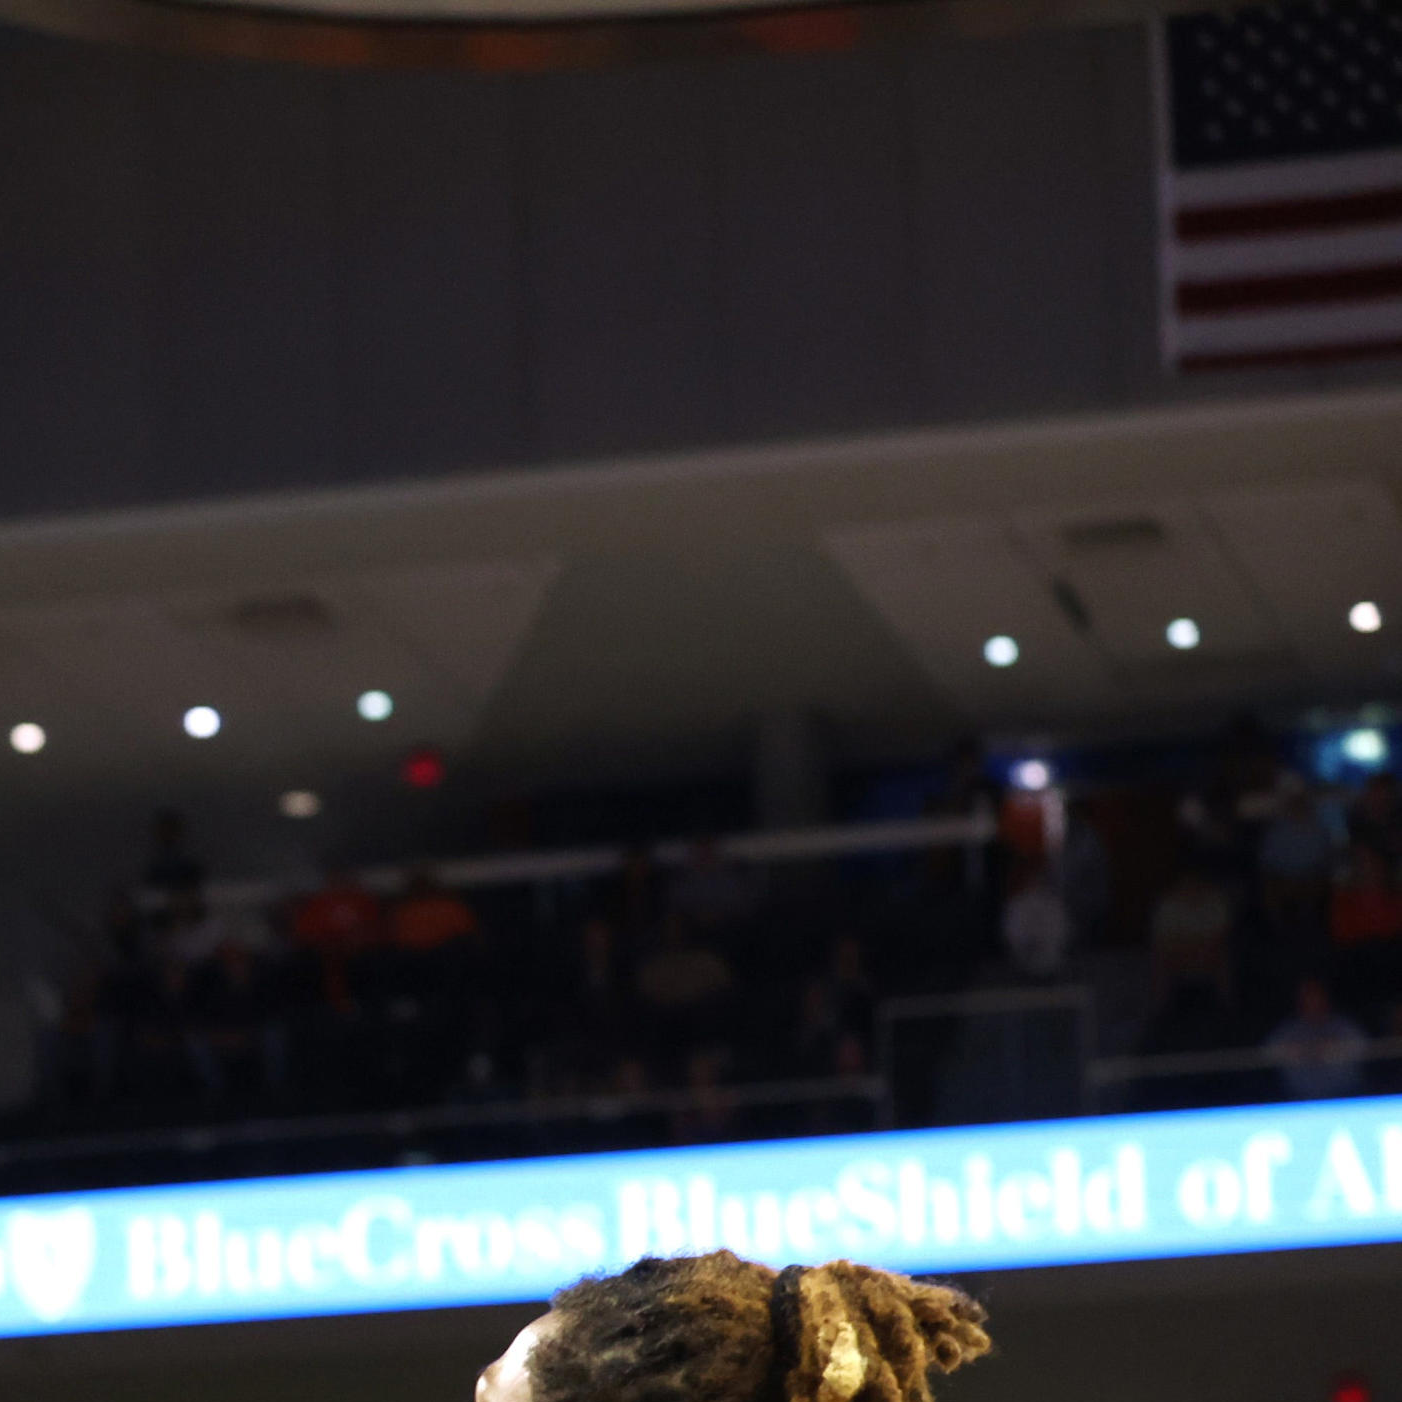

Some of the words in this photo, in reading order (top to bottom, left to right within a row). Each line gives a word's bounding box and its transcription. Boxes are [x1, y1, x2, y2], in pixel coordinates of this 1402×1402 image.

[126, 1199, 606, 1298] BlueCross
[619, 1142, 1147, 1263] BlueShield
[1177, 1129, 1291, 1227] of
